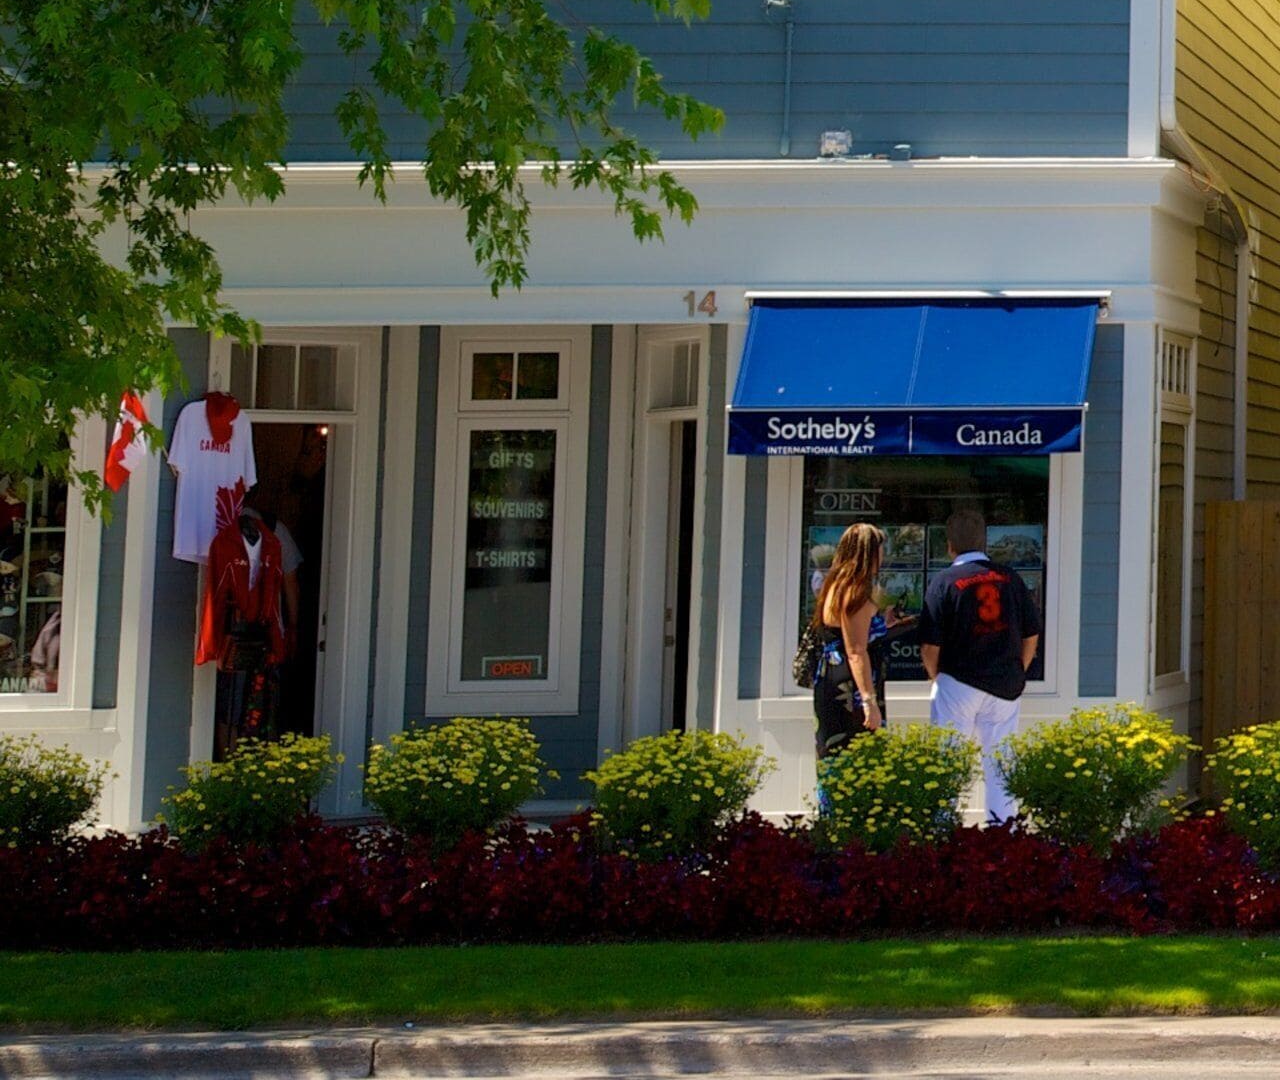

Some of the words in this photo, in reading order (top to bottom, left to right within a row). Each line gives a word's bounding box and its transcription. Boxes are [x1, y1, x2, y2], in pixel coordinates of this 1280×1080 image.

[683, 291, 718, 318] 14
[767, 416, 876, 446] Sotheby's
[956, 422, 1042, 446] Canada
[767, 445, 839, 454] INTERNATIONAL
[841, 445, 875, 454] REALTY
[488, 452, 535, 469] GIFTS
[474, 502, 544, 519] SOUVENIRS
[820, 493, 877, 511] OPEN
[475, 551, 536, 568] T-SHIRTS
[491, 662, 532, 677] OPEN
[0, 677, 46, 693] ANADA
